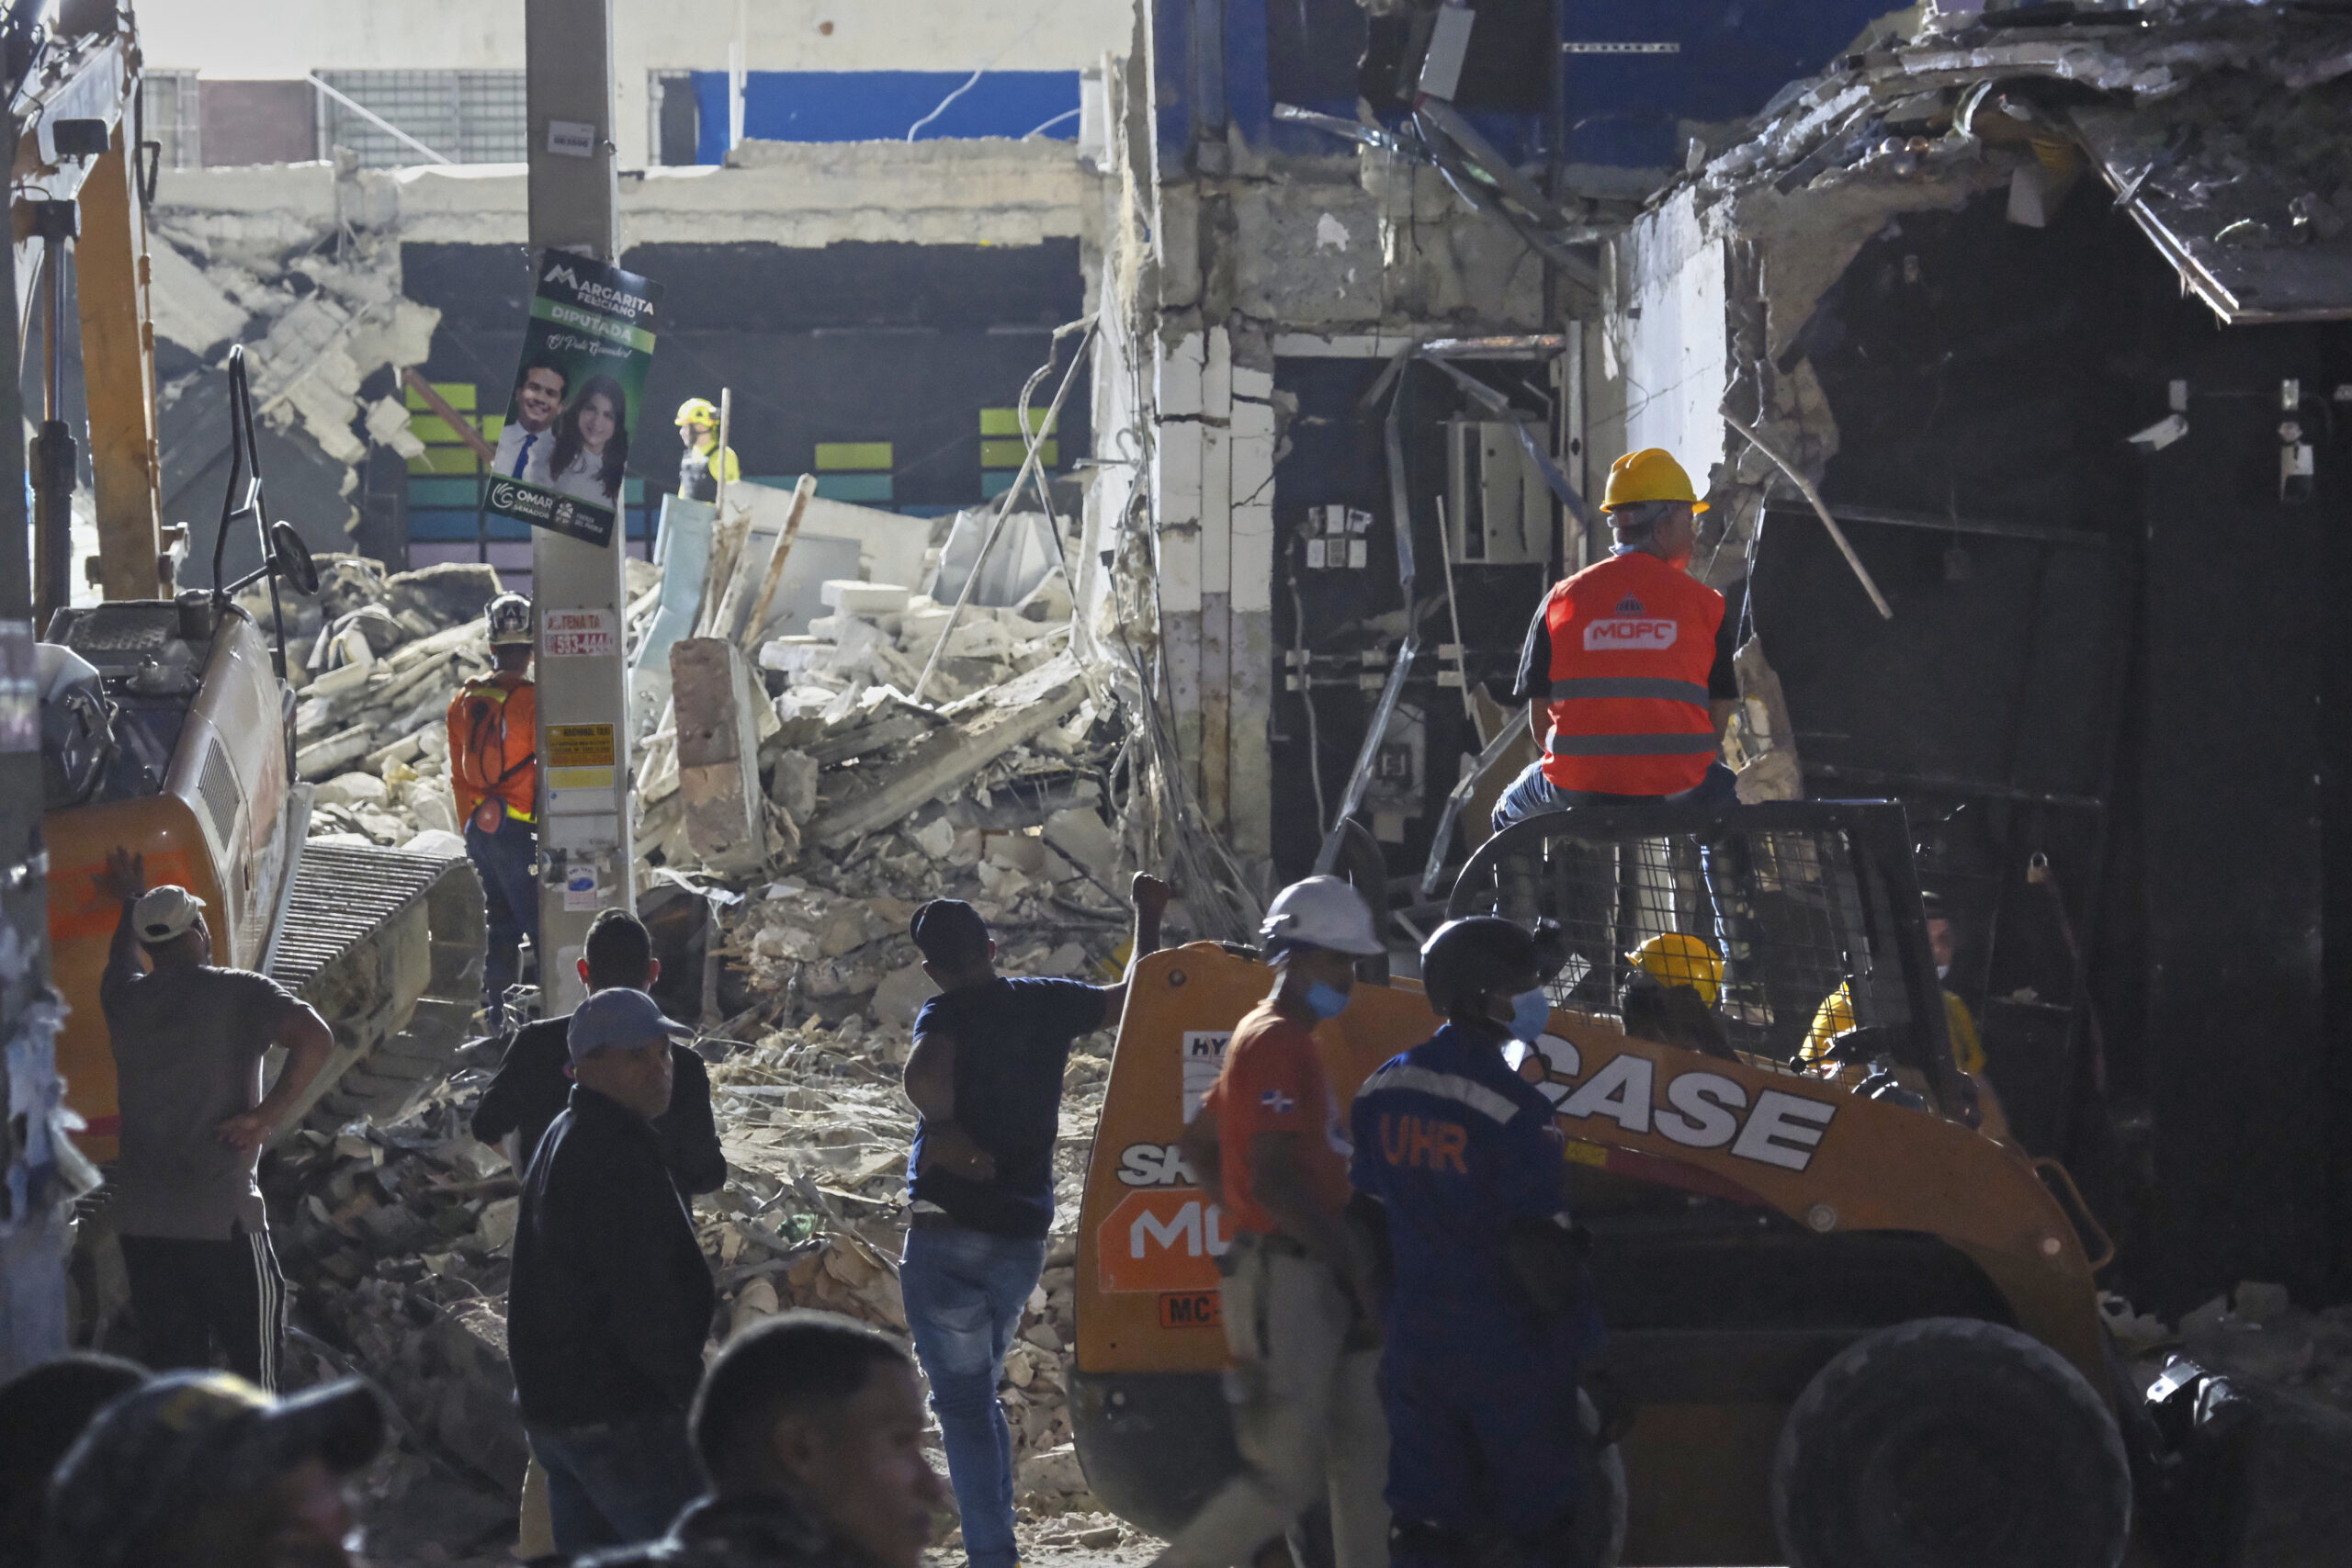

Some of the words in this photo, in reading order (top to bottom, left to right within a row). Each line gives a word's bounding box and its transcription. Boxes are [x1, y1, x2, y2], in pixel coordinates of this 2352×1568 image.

[544, 264, 654, 316] MARGARITA
[577, 292, 636, 318] FELICIANO
[551, 305, 632, 344] DIPUTADA
[516, 490, 553, 509] OMAR
[514, 503, 549, 519] SENADOR
[1592, 622, 1672, 640] MOPC
